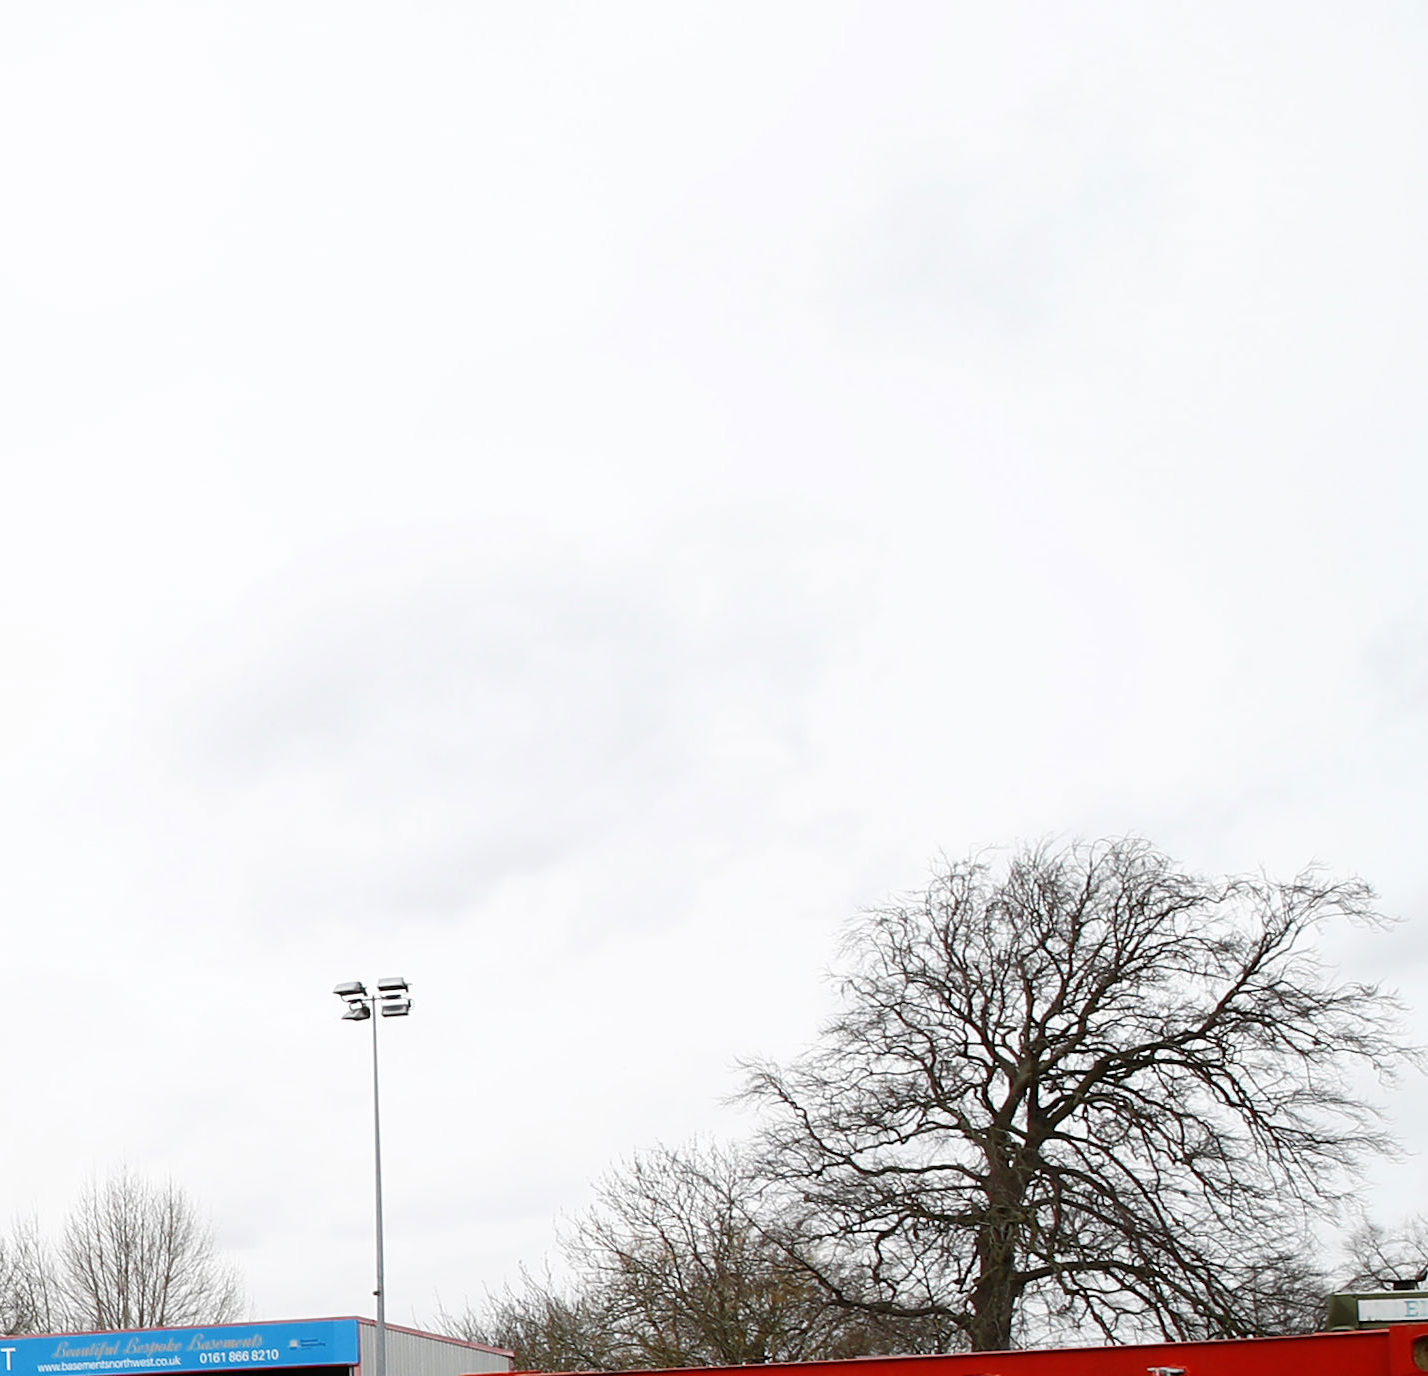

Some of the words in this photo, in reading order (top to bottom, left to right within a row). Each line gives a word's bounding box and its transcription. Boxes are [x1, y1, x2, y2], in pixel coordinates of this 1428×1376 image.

[37, 1355, 182, 1374] www.basementsnorthwest.co.uk
[199, 1351, 227, 1365] 0161
[229, 1350, 249, 1363] 866
[251, 1348, 280, 1362] 8210
